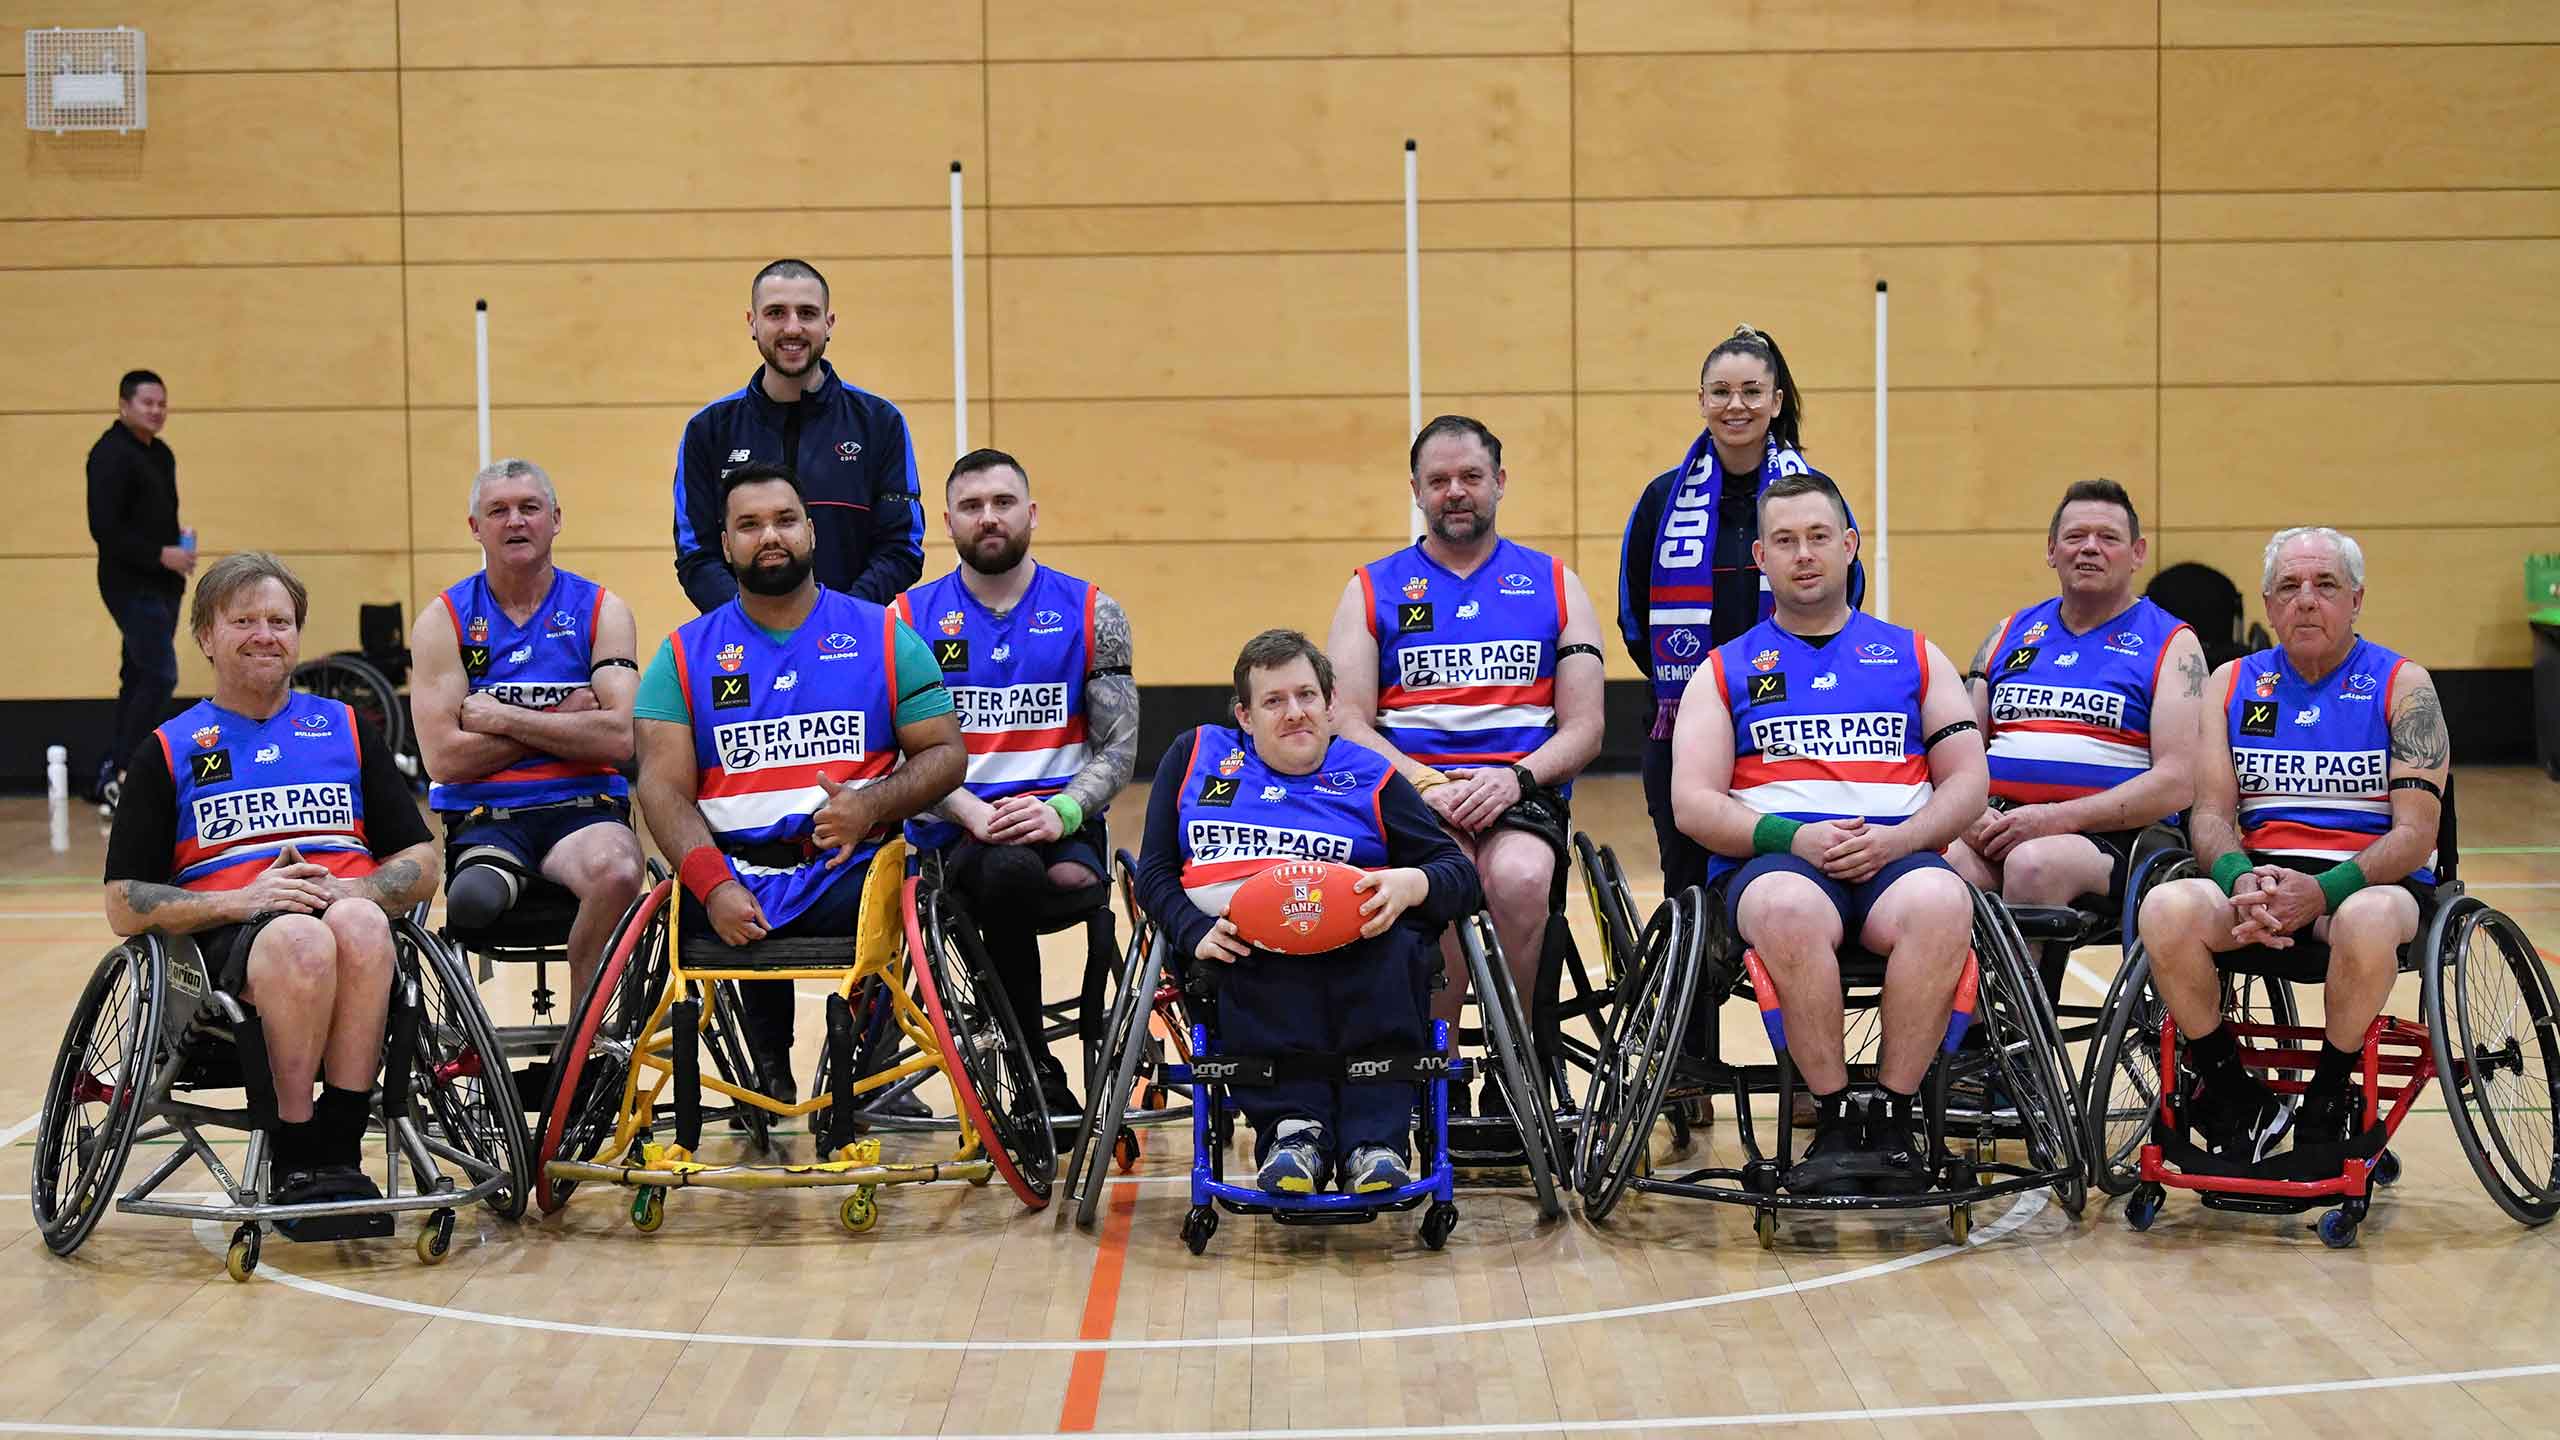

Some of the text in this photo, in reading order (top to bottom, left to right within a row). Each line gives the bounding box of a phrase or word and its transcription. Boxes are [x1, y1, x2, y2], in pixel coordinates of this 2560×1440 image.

[1658, 453, 1713, 569] CDFC
[1403, 644, 1538, 672] PETER PAGE
[1446, 666, 1535, 684] HYUNDAI
[1656, 664, 1701, 681] MEMBE
[952, 686, 1063, 711] ETER PAGE
[1994, 686, 2120, 715] PETER PAGE
[977, 708, 1063, 728] HYUNDAI
[719, 715, 860, 750] PETER PAGE
[1754, 716, 1904, 747] PETER PAGE
[764, 739, 860, 762] HYUNDAI
[1803, 739, 1902, 757] HYUNDAI
[2234, 751, 2382, 777] PETER PAGE
[2275, 777, 2384, 793] HYUNDAI
[199, 787, 349, 824] PETER PAGE
[249, 810, 351, 831] HYUNDAI
[1193, 824, 1268, 847] PETER
[1279, 831, 1348, 862] PAGE
[1282, 902, 1322, 915] SANFL
